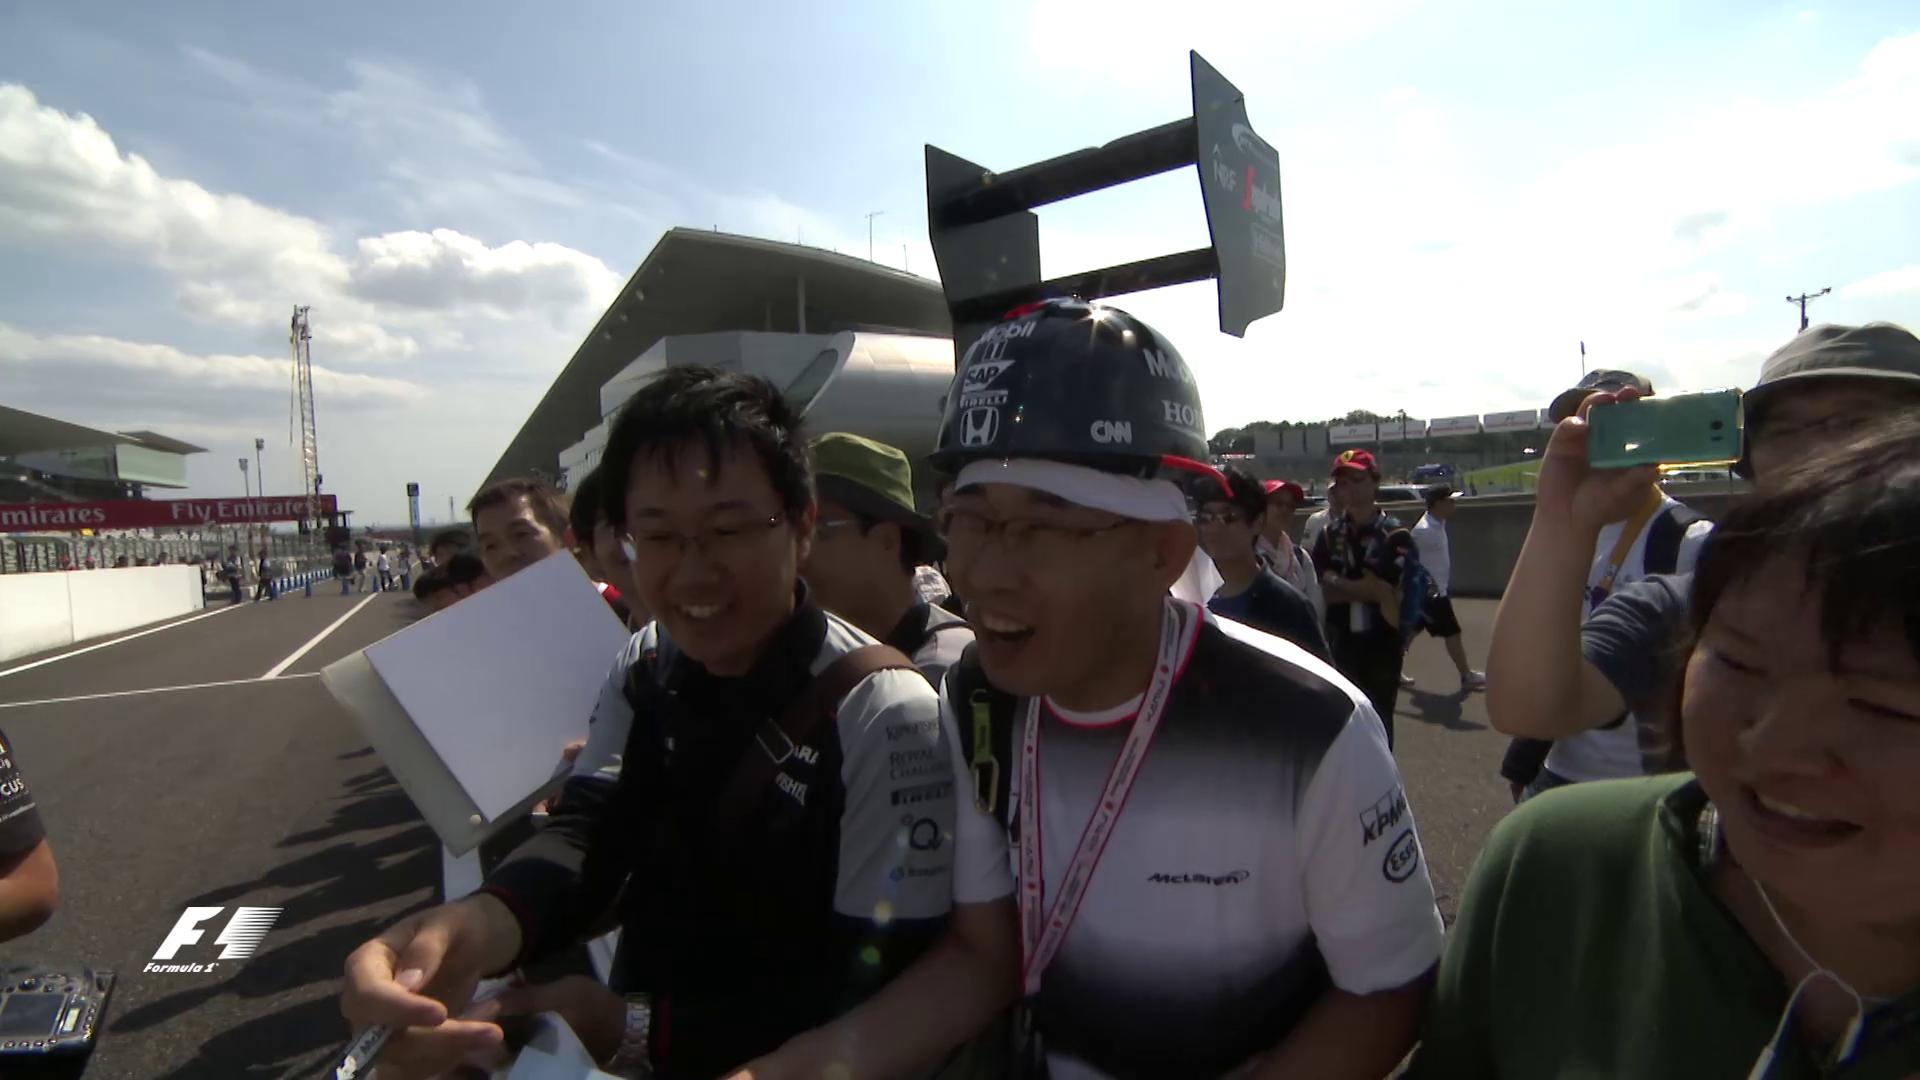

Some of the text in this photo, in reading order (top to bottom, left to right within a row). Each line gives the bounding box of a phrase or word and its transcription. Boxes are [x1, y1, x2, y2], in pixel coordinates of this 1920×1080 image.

[966, 365, 1001, 386] SAP
[1090, 420, 1133, 444] CNN
[171, 501, 211, 521] Fly
